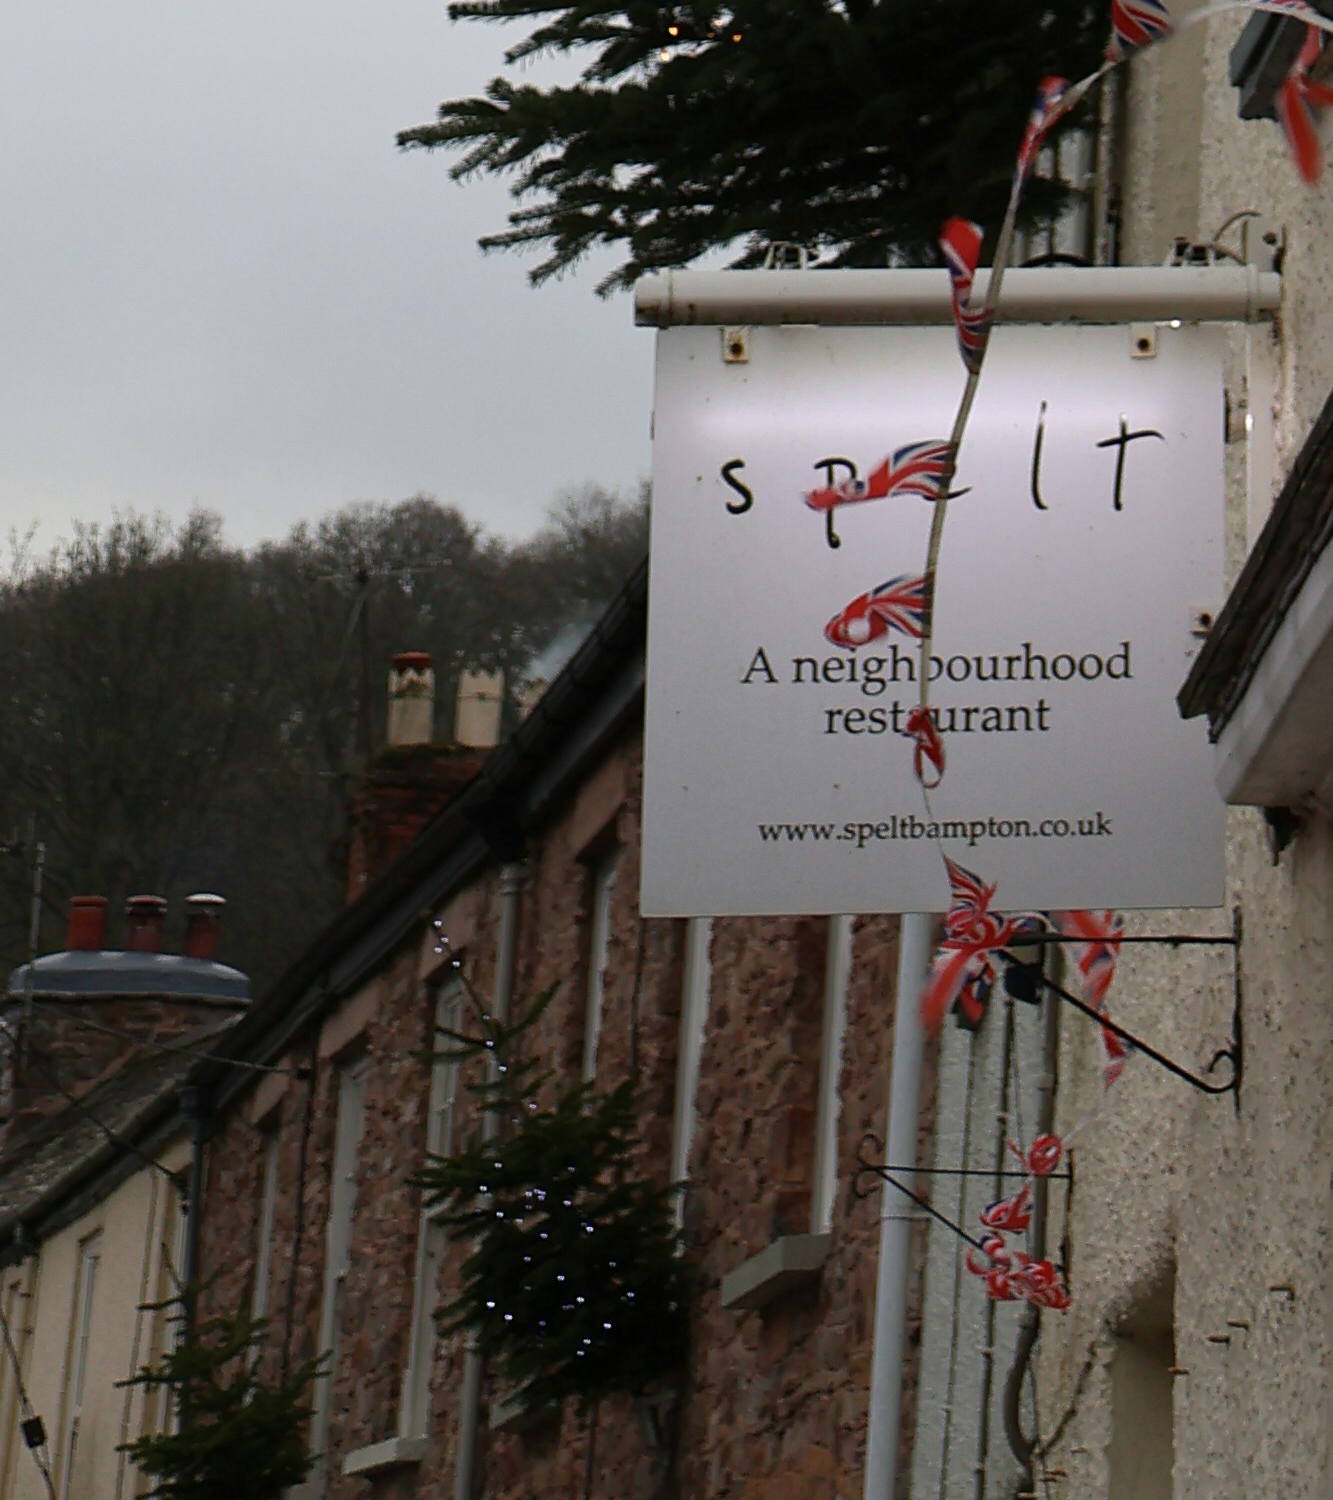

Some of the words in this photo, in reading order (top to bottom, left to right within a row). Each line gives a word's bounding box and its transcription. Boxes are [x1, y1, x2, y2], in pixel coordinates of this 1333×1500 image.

[720, 400, 1164, 549] splt
[740, 645, 779, 684] A
[823, 698, 1051, 736] resturant
[758, 811, 1113, 849] www.speltbampton.co.uk
